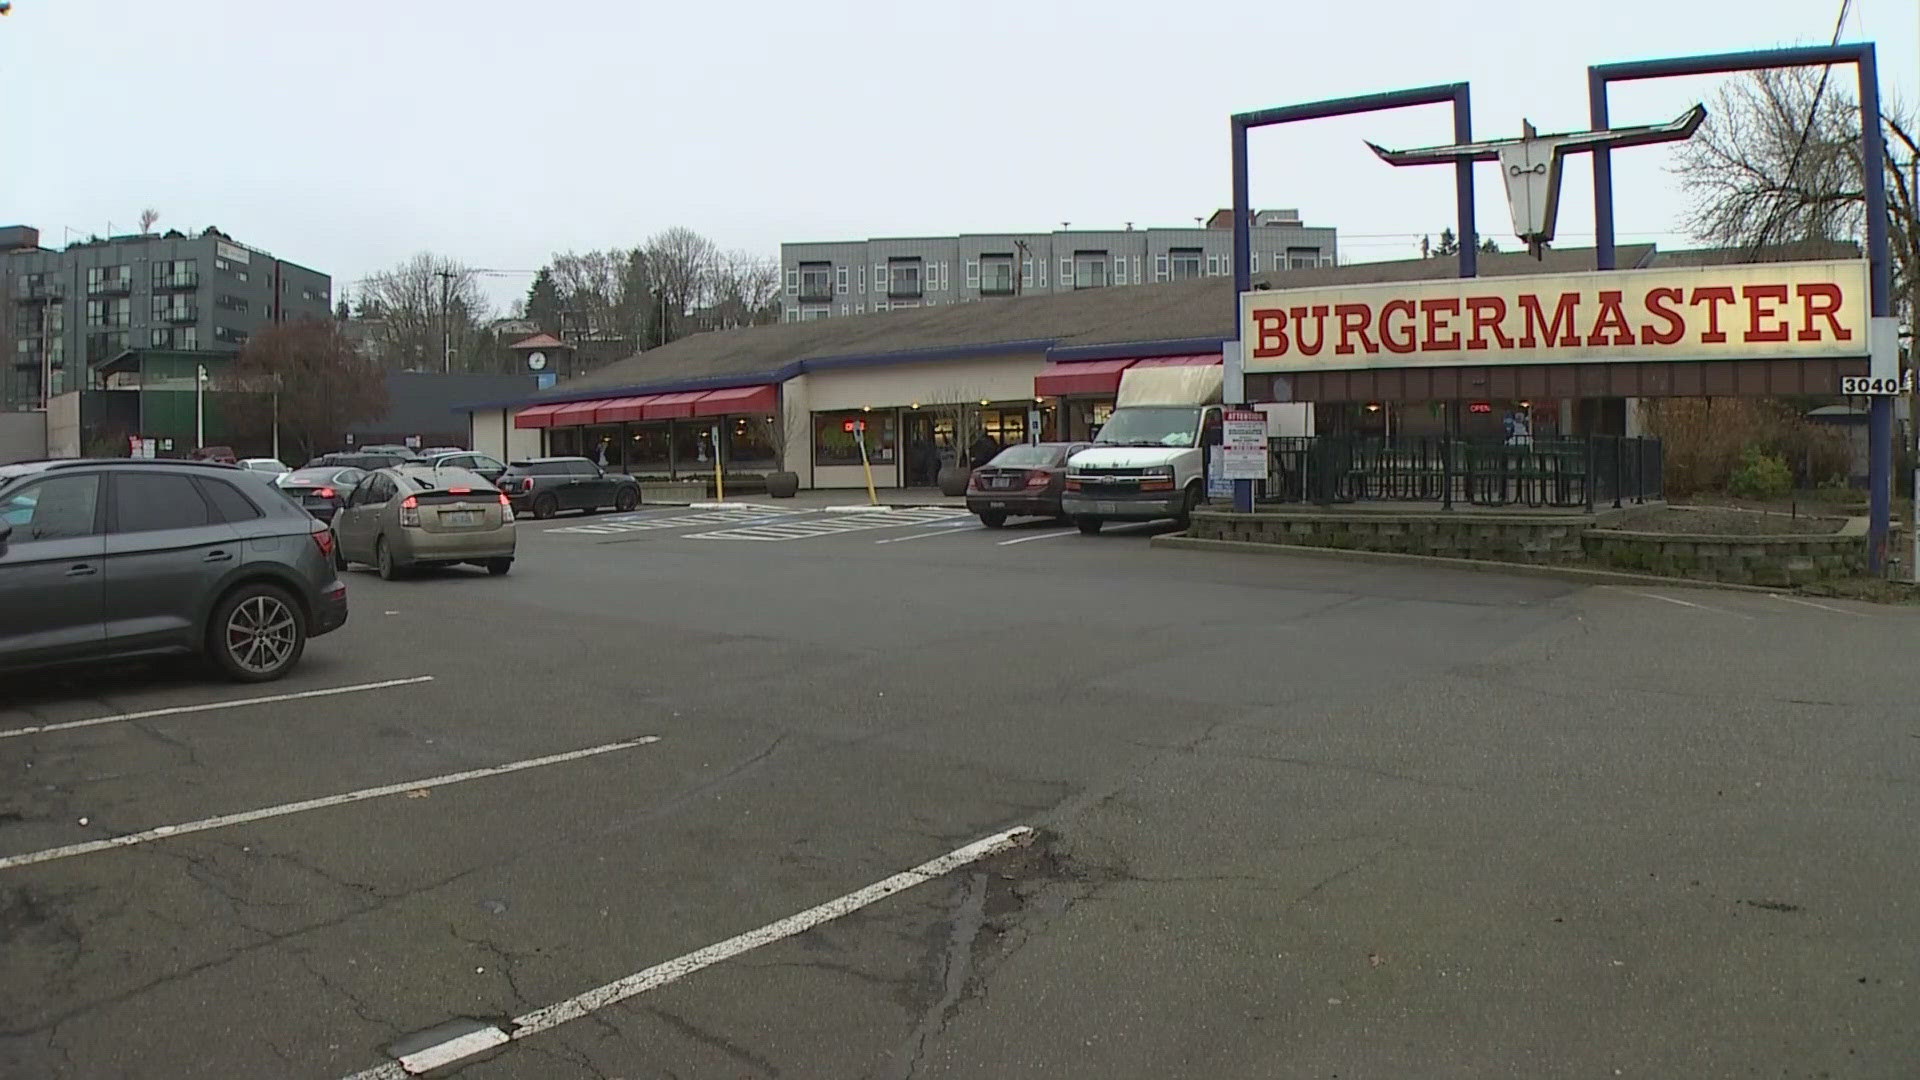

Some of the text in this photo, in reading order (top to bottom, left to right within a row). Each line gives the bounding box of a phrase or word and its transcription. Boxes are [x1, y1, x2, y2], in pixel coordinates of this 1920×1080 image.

[1253, 283, 1852, 358] BURGERMASTER
[1845, 378, 1897, 392] 3040
[1470, 404, 1491, 413] OPEN
